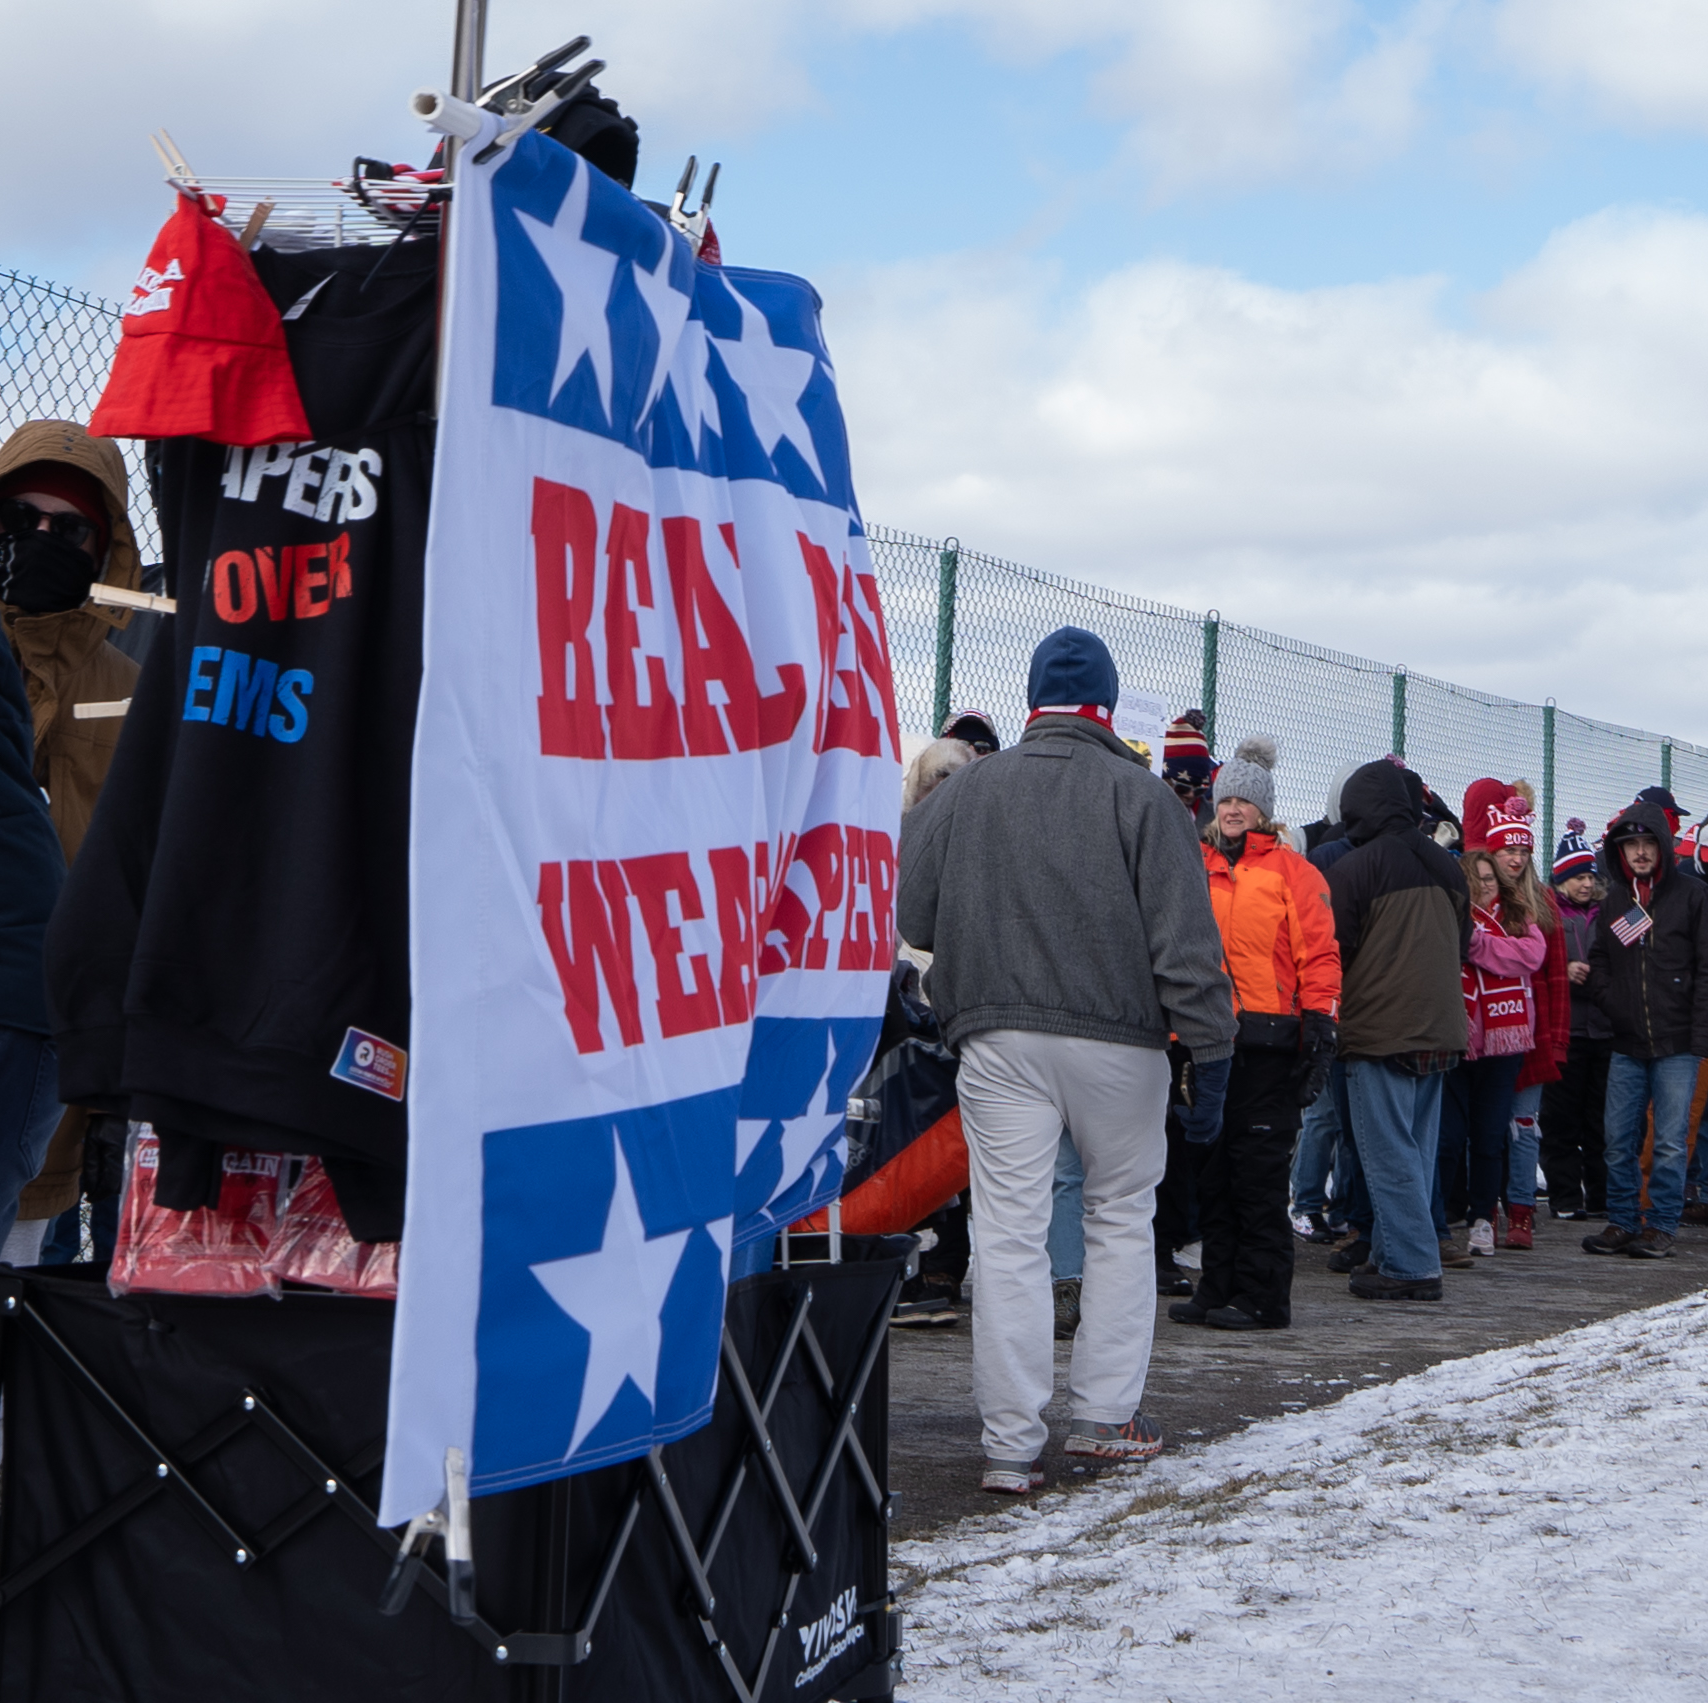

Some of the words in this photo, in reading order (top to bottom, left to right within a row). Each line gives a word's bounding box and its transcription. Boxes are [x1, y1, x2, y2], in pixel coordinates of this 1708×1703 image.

[213, 531, 353, 624] OVER
[531, 476, 807, 760] REAL
[1487, 999, 1524, 1017] 2024
